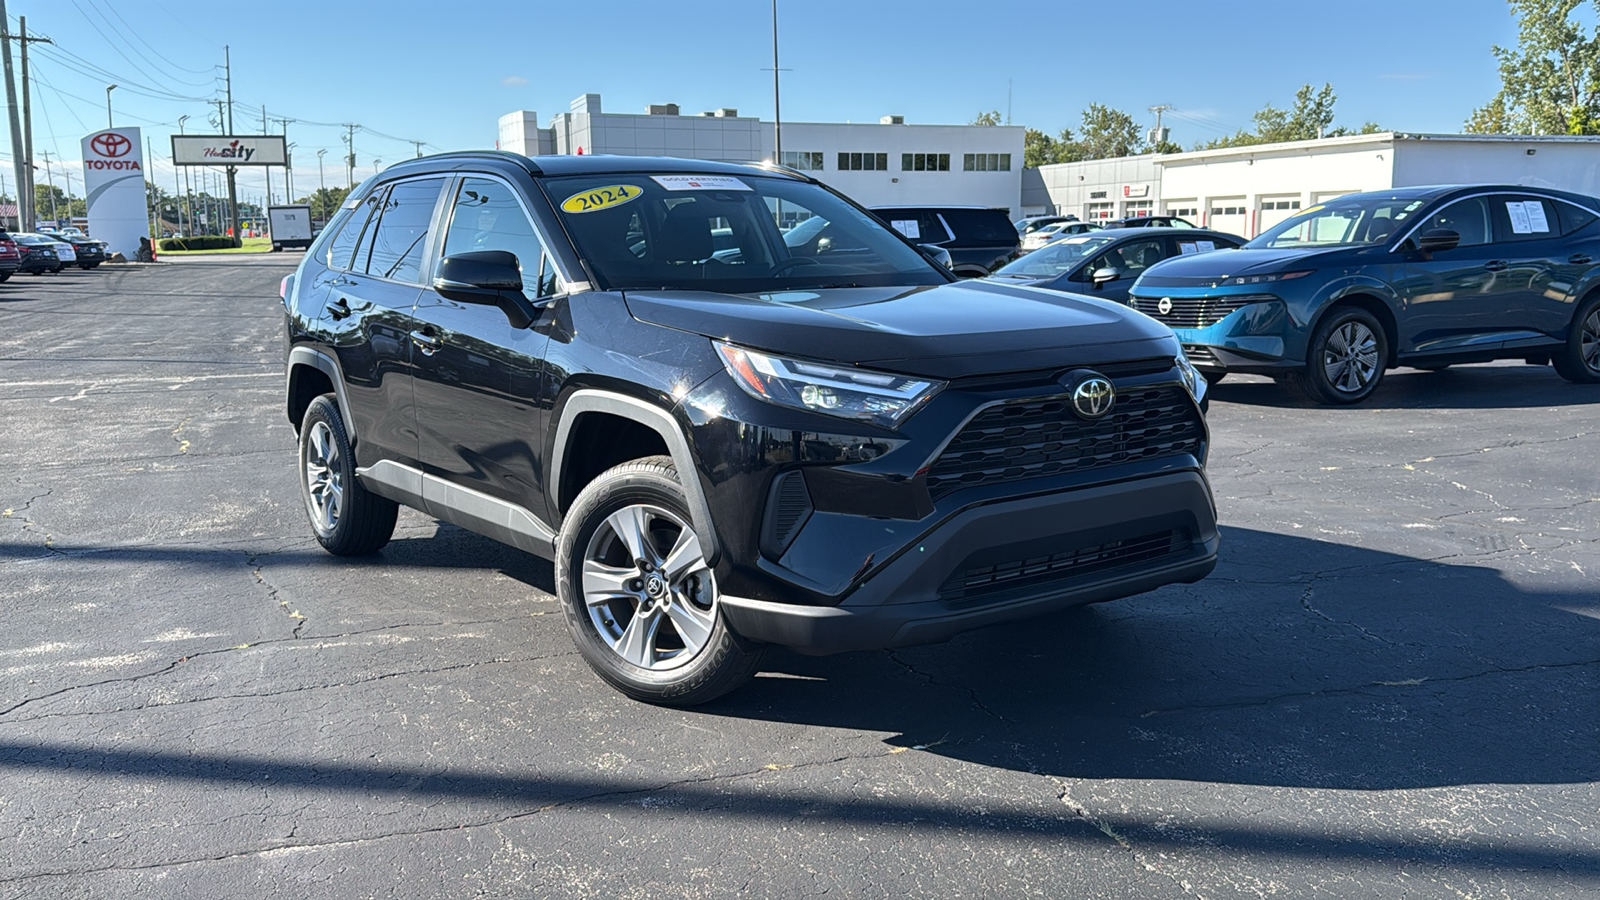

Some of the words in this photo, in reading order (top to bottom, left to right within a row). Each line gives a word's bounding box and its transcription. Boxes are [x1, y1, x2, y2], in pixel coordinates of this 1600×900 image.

[85, 159, 141, 170] TOYOTA
[575, 185, 630, 211] 2024
[661, 631, 733, 697] OUNTRY
